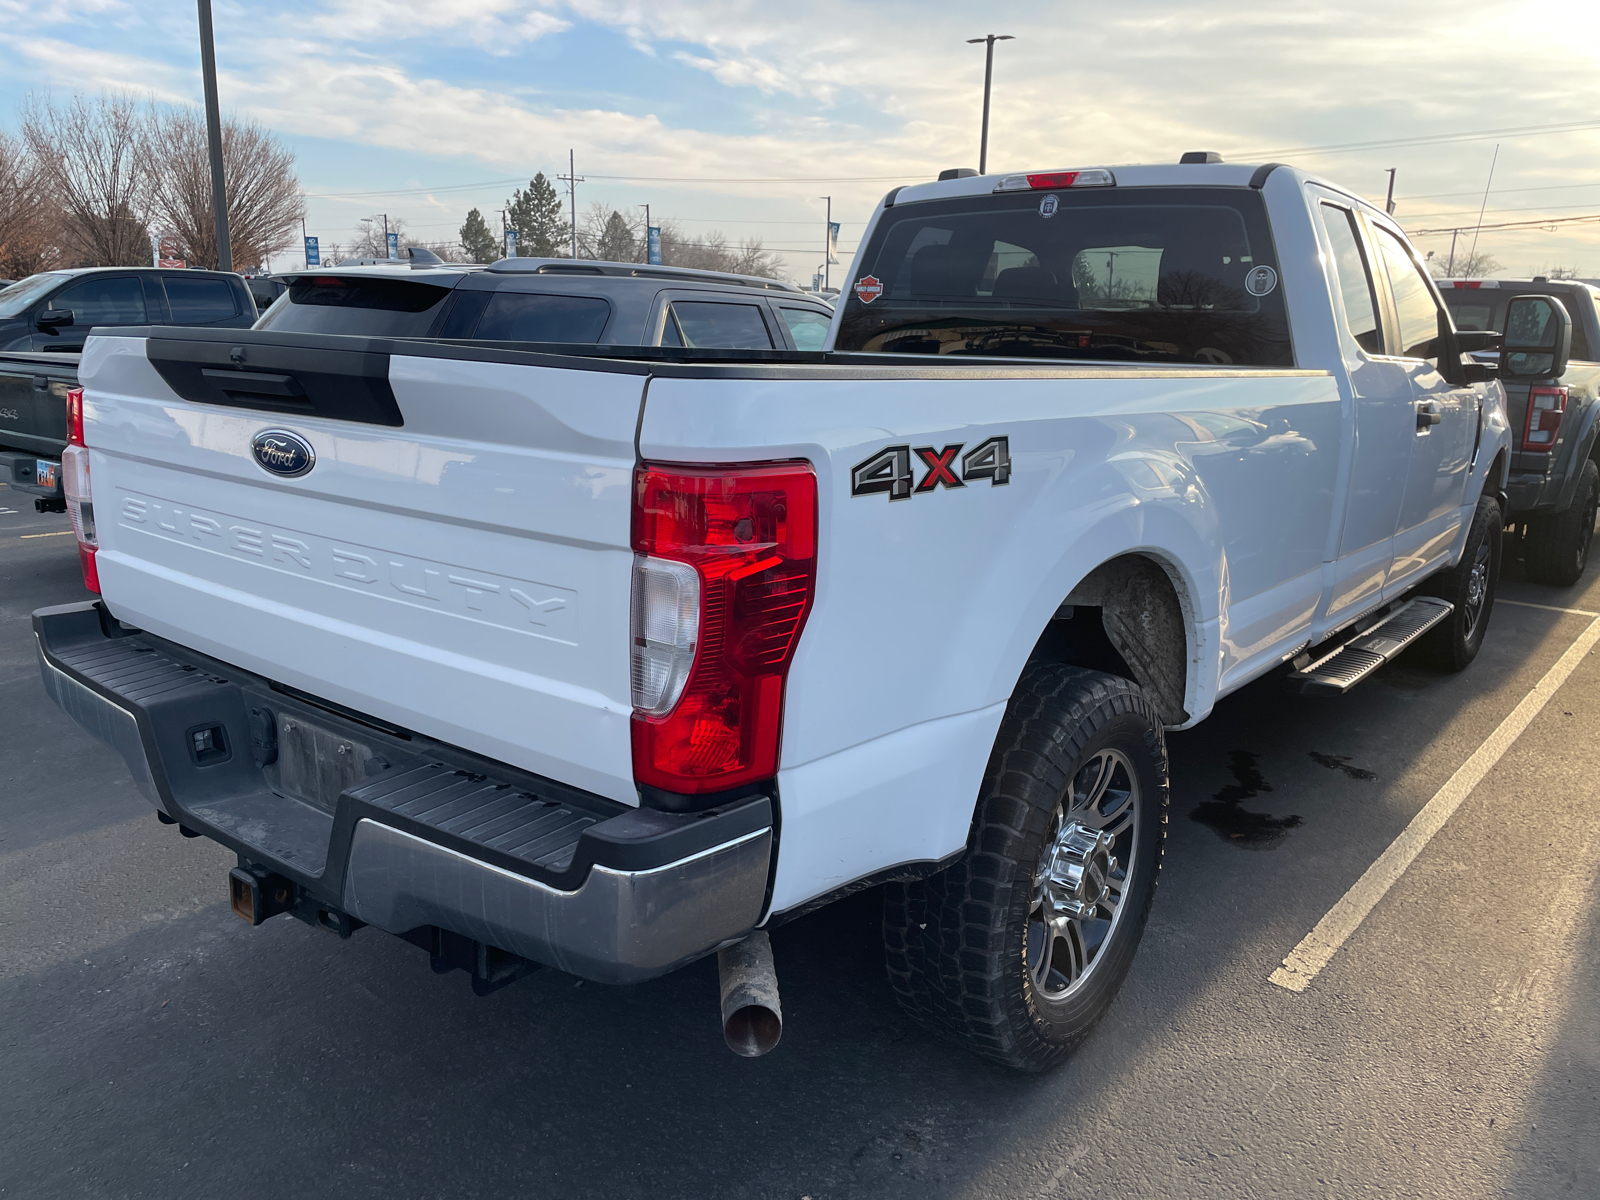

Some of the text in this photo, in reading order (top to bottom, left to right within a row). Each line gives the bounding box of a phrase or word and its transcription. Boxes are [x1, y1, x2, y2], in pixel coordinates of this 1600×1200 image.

[261, 438, 297, 467] Ford
[121, 497, 567, 627] SUPER DUTY
